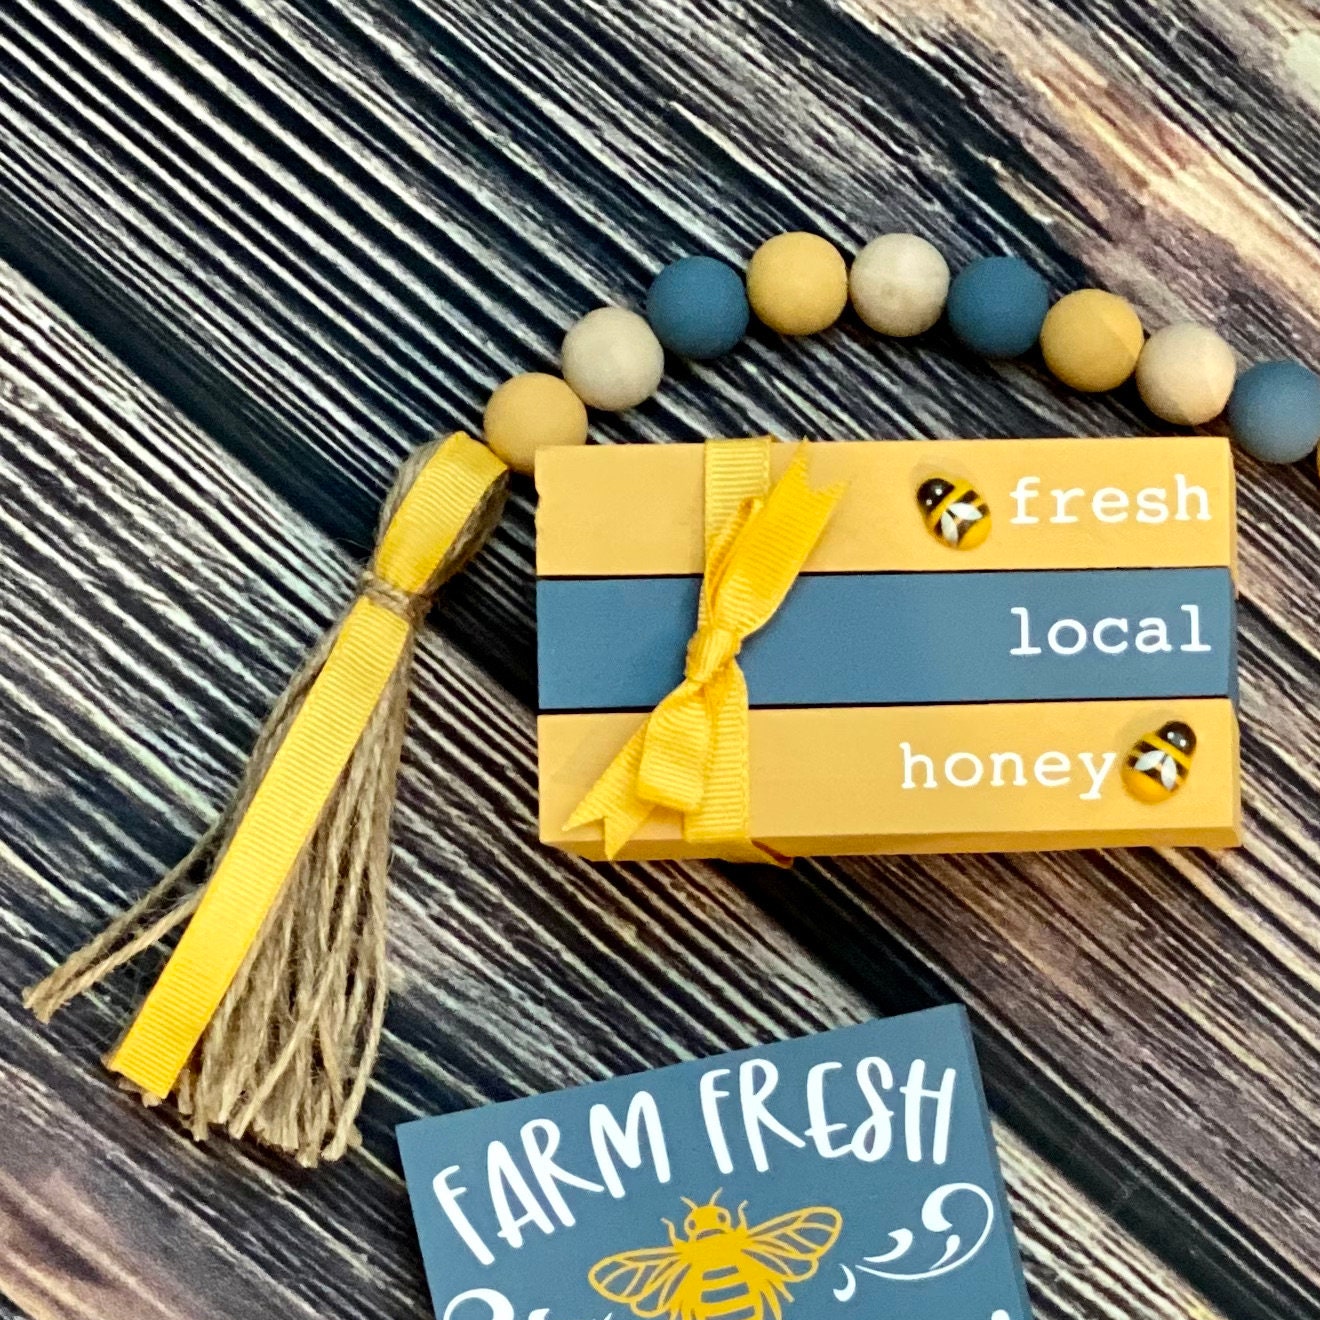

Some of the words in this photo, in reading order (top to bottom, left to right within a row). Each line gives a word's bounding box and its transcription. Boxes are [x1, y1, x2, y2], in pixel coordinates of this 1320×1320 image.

[1009, 473, 1212, 524] fresh
[1009, 605, 1212, 657] local
[900, 742, 1118, 801] honey
[432, 1090, 671, 1266] FARM
[699, 1056, 957, 1174] FRESH
